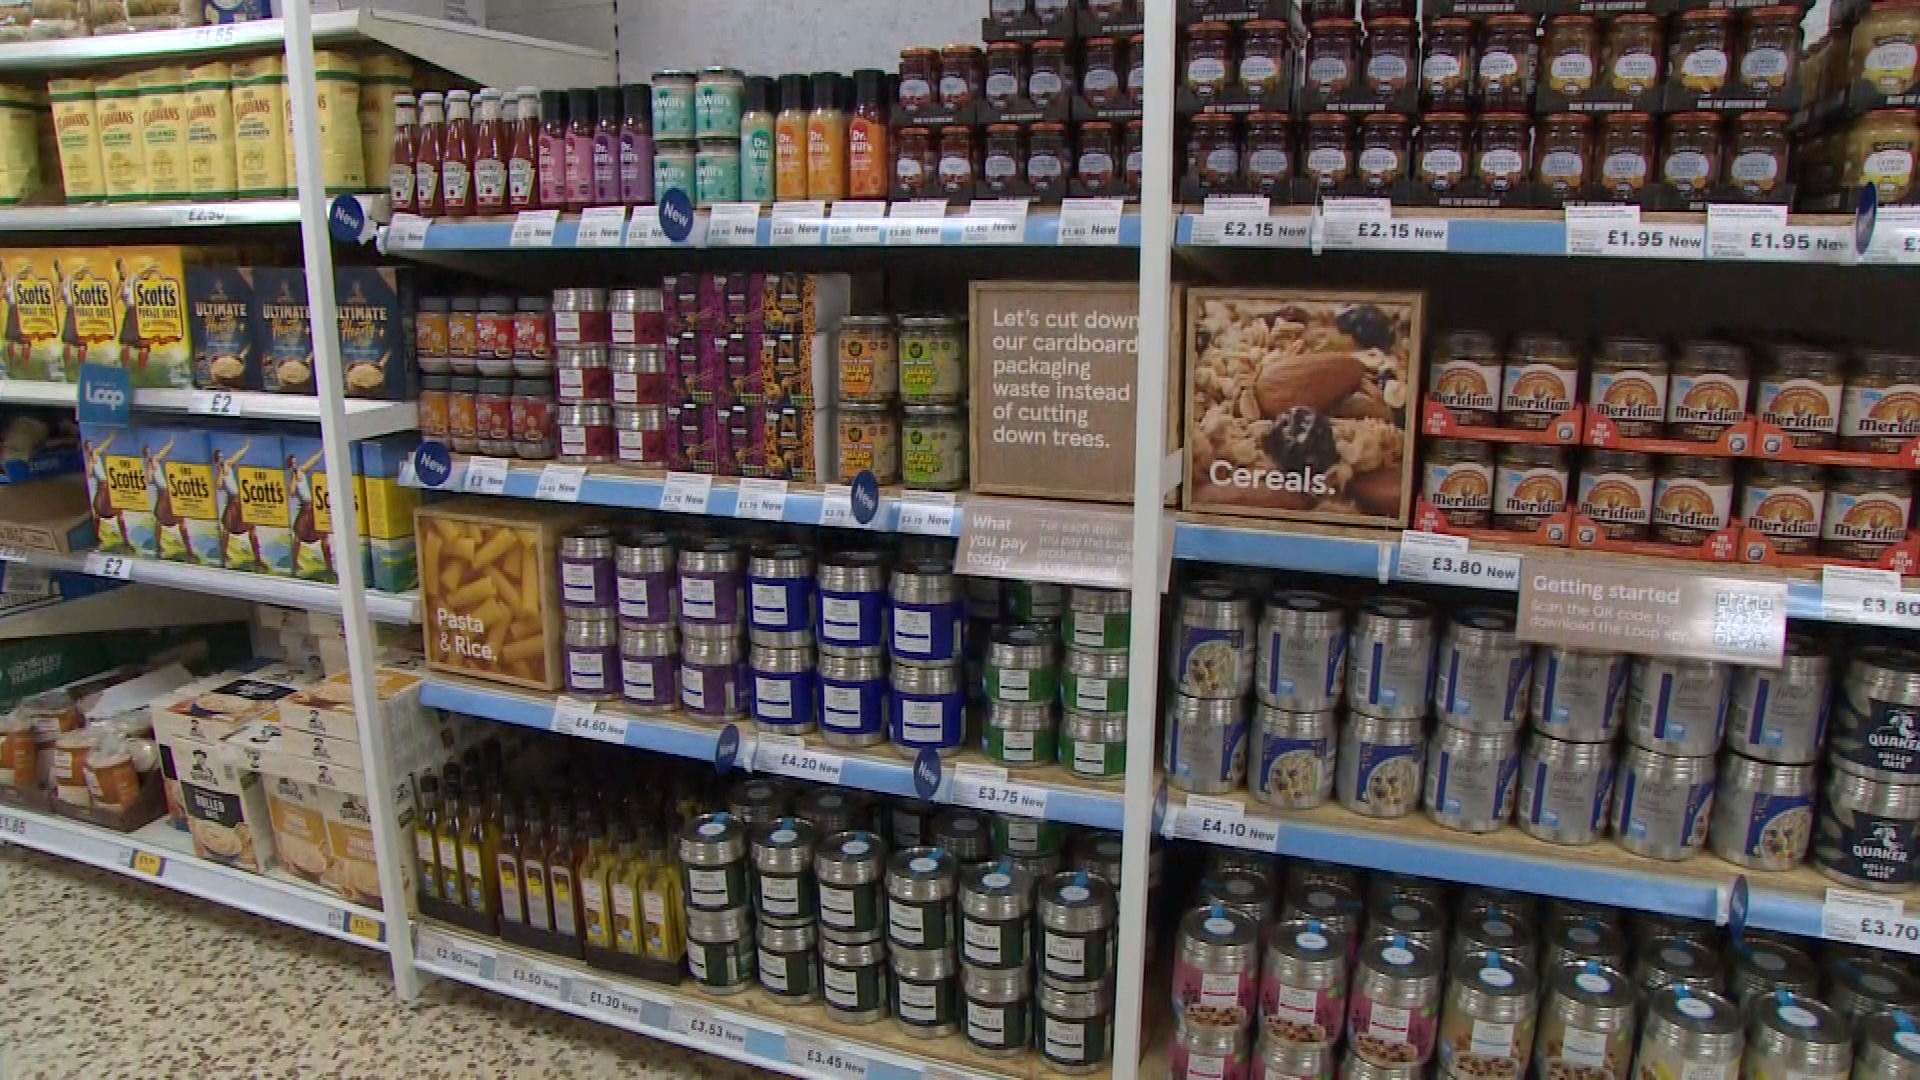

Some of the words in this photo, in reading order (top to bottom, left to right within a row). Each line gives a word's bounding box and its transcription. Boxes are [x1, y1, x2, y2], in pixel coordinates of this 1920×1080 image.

[335, 207, 360, 229] New
[664, 202, 689, 227] New
[735, 225, 755, 235] New
[798, 223, 820, 233] New
[992, 222, 1017, 231] New
[1091, 224, 1117, 236] New
[1224, 221, 1274, 238] £2.15
[1279, 226, 1307, 238] New
[1358, 222, 1409, 239] £2.15
[1415, 227, 1445, 239] New
[1607, 230, 1663, 247] £1.95
[1669, 235, 1702, 247] New
[1751, 233, 1810, 250] £1.95
[17, 283, 51, 304] Scott's
[74, 284, 108, 306] Scott's
[137, 284, 176, 306] Scott's
[196, 303, 247, 317] ULTIMATE
[993, 308, 1039, 328] Let's
[1045, 312, 1079, 328] cut
[1084, 310, 1139, 329] down
[993, 335, 1028, 350] our
[1033, 333, 1138, 354] cardboard
[993, 356, 1091, 381] packaging
[86, 382, 125, 411] Loop
[993, 381, 1050, 399] waste
[1056, 381, 1131, 402] instead
[211, 394, 232, 413] £2
[993, 402, 1013, 420] of
[1018, 404, 1089, 428] cutting
[993, 426, 1046, 445] down
[1053, 428, 1110, 448] trees.
[421, 453, 447, 475] New
[109, 467, 147, 490] Scott's
[169, 474, 209, 498] Scott's
[1209, 459, 1336, 495] Cereals.
[242, 479, 284, 503] Scott's
[558, 484, 576, 493] New
[686, 494, 704, 504] New
[762, 500, 783, 511] New
[928, 514, 951, 526] New
[972, 515, 1012, 531] What
[970, 534, 997, 550] you
[999, 537, 1028, 554] pay
[104, 558, 123, 576] £2
[967, 551, 1010, 571] today
[1433, 557, 1482, 575] £3.80
[1487, 567, 1516, 579] New
[1534, 576, 1603, 601] Getting
[1609, 585, 1680, 605] started
[1531, 600, 1562, 614] Scan
[1567, 603, 1590, 617] the
[1618, 608, 1652, 622] code
[1863, 598, 1920, 617] £3.80
[437, 607, 484, 634] Pasta
[1530, 616, 1594, 632] download
[1599, 620, 1621, 634] the
[1625, 623, 1659, 640] Loop
[440, 636, 450, 652] &
[455, 635, 497, 662] Rice.
[576, 717, 607, 733] £4.60
[781, 754, 817, 771] £4.20
[819, 764, 840, 775] New
[978, 786, 1018, 804] £3.75
[1021, 796, 1044, 809] New
[1202, 818, 1246, 838] £4.10
[1250, 828, 1275, 842] New
[1852, 844, 1908, 862] QUAKER
[1861, 917, 1919, 942] £3.70
[591, 991, 620, 1009] £1.30
[726, 1030, 744, 1043] New
[845, 1061, 866, 1075] New
